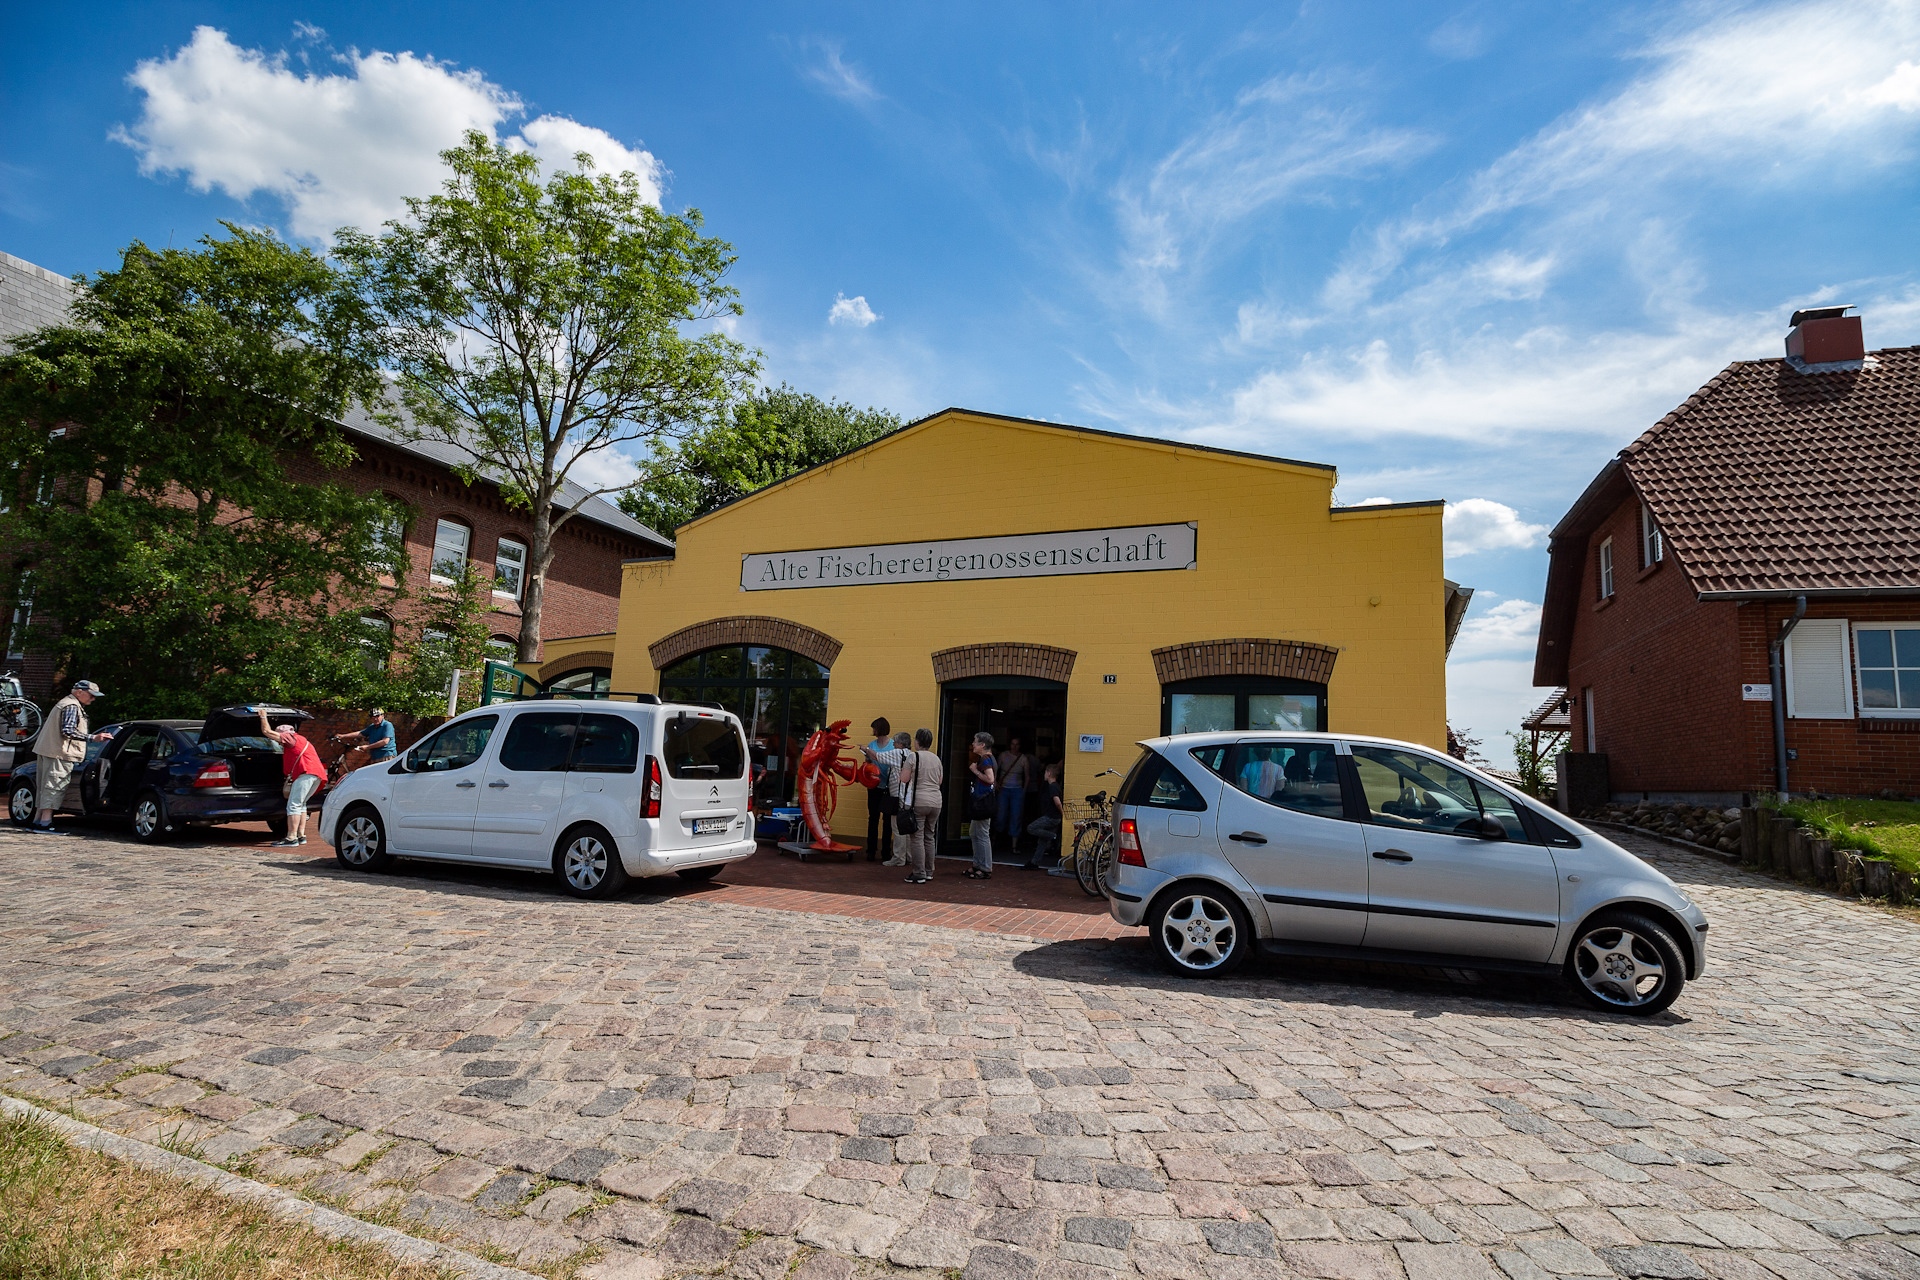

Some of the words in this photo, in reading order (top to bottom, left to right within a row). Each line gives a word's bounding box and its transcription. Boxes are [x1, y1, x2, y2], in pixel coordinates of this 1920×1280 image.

[759, 558, 809, 583] Alte
[815, 533, 1168, 580] Fischereigenossenschaft
[1106, 675, 1115, 683] 12
